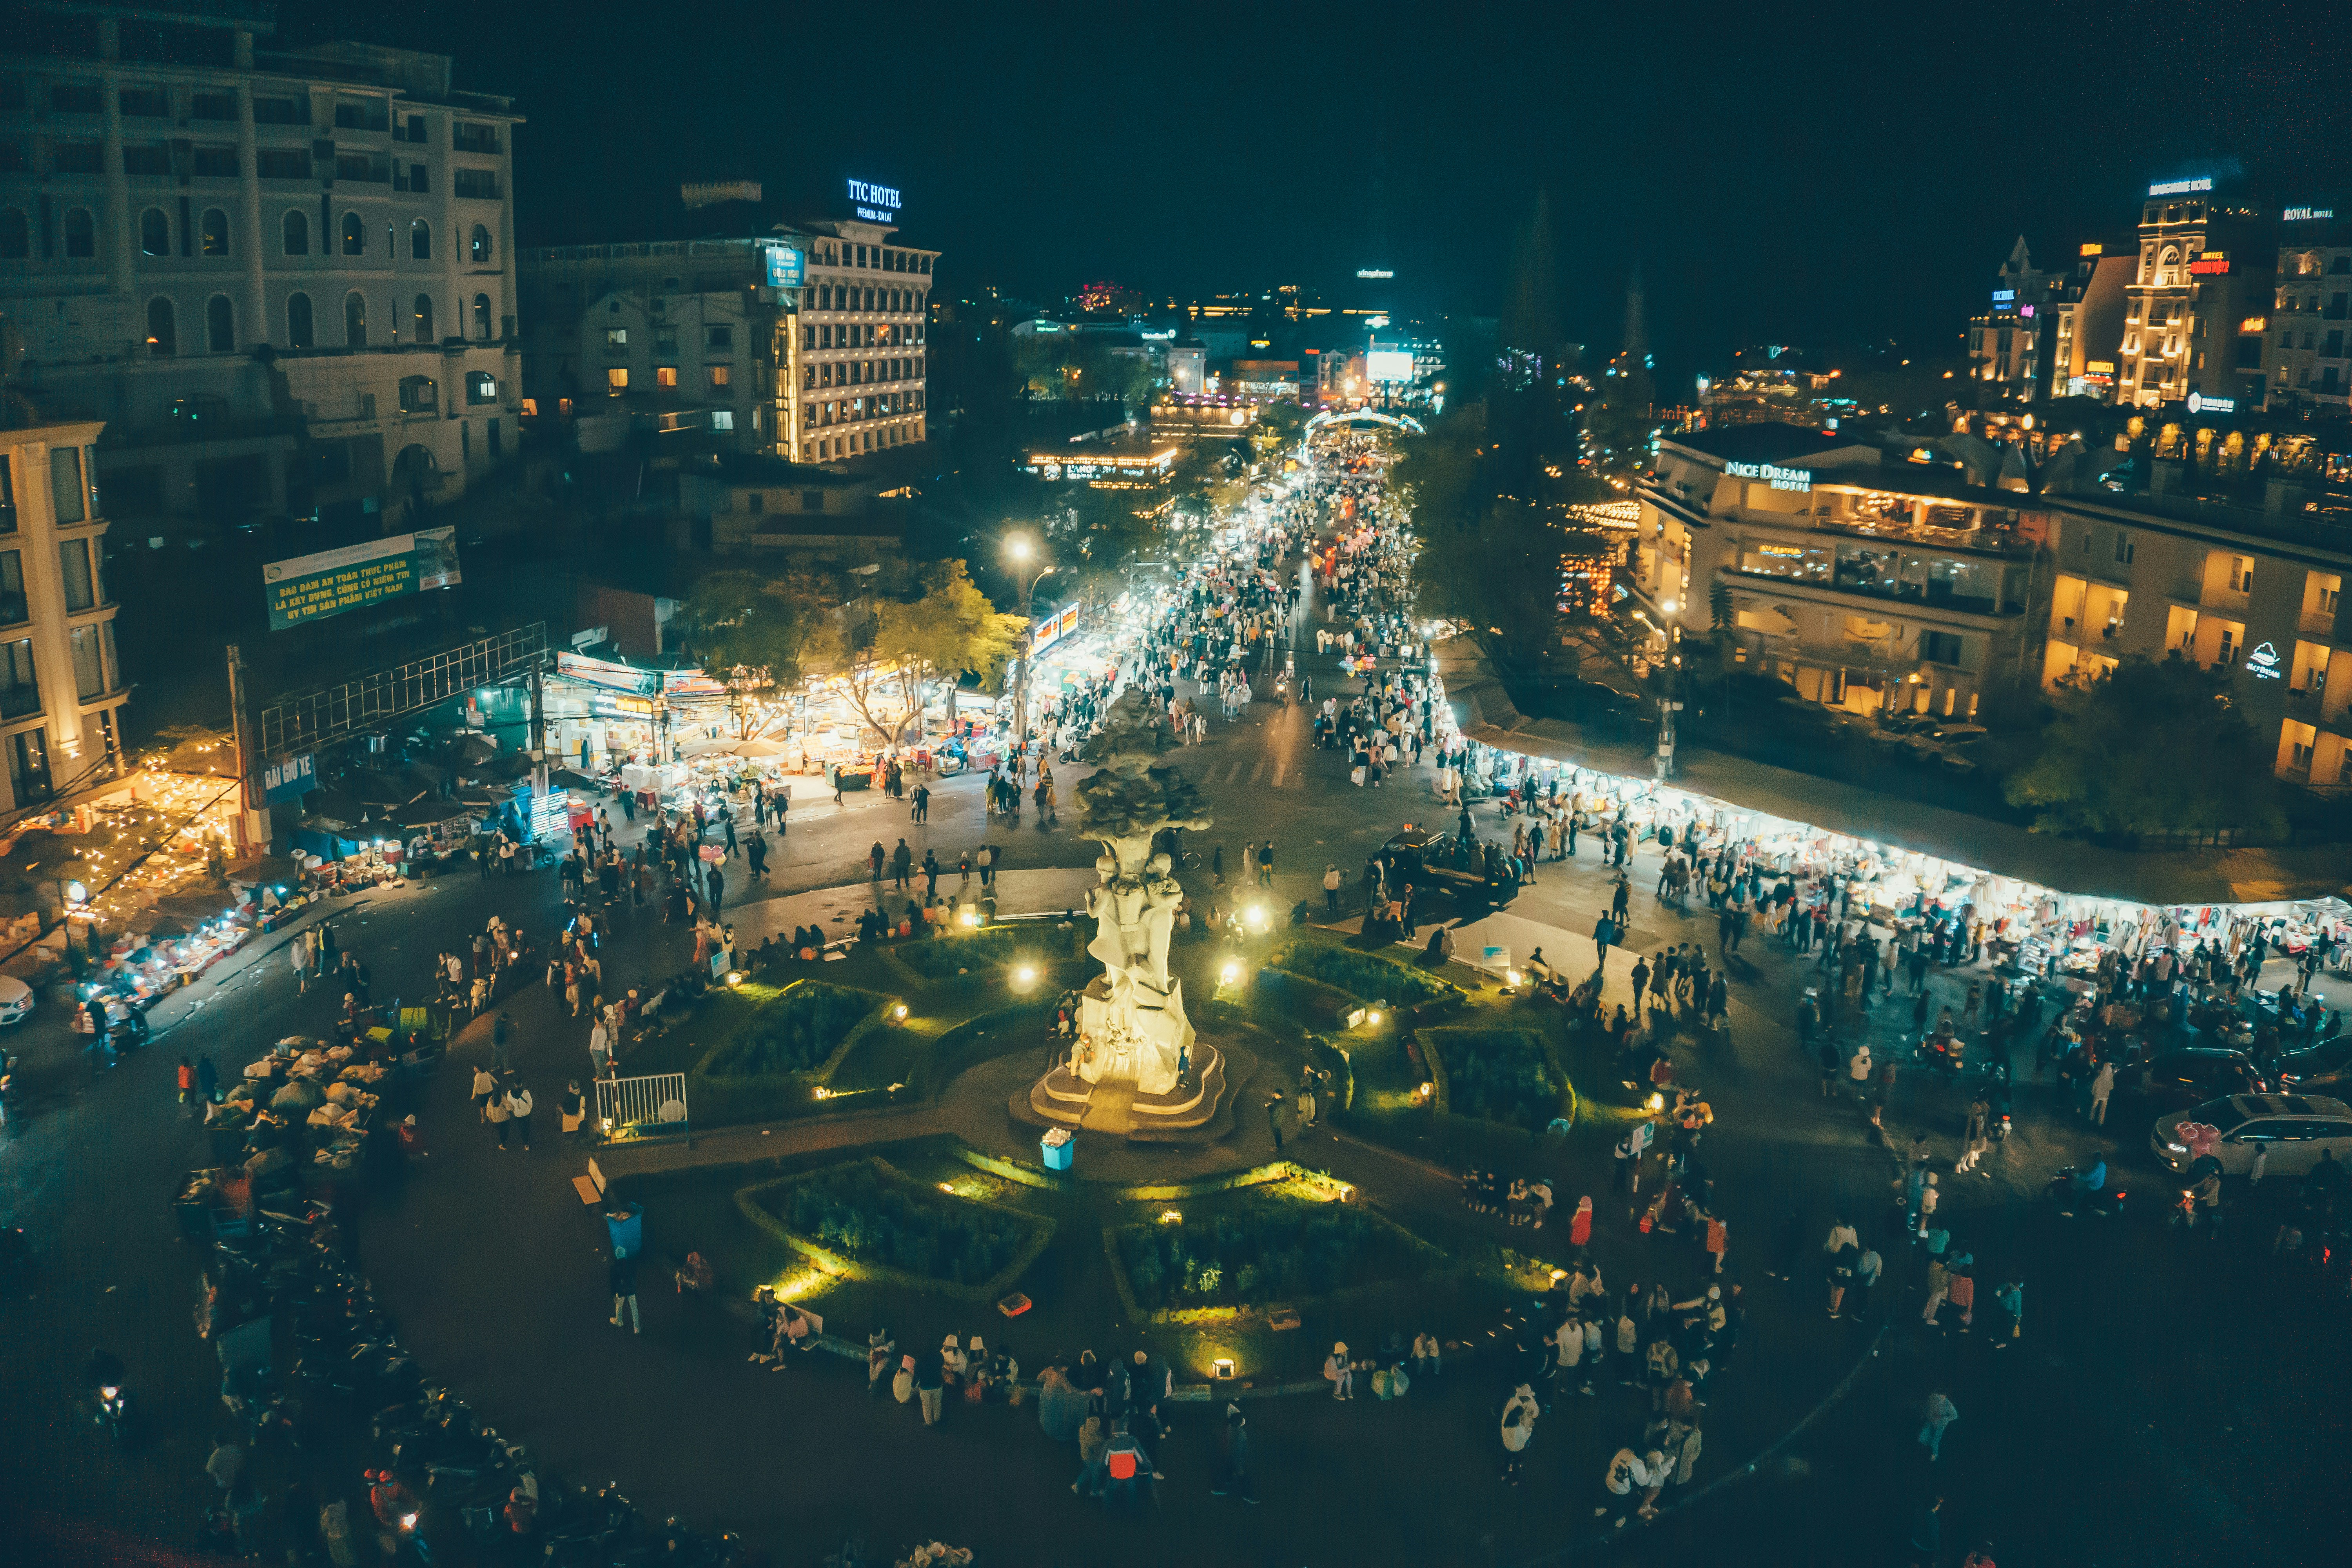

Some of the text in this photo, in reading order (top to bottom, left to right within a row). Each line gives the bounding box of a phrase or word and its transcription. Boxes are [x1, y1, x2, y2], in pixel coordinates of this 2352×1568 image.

[849, 179, 901, 209] TTC HOTEL
[2284, 207, 2312, 220] ROYAL
[1726, 461, 1810, 482] NICE DREAM
[1771, 479, 1811, 493] HOTEL
[322, 577, 333, 587] AN
[385, 583, 403, 594] NAM
[265, 765, 281, 790] BÃI
[299, 755, 312, 777] XE
